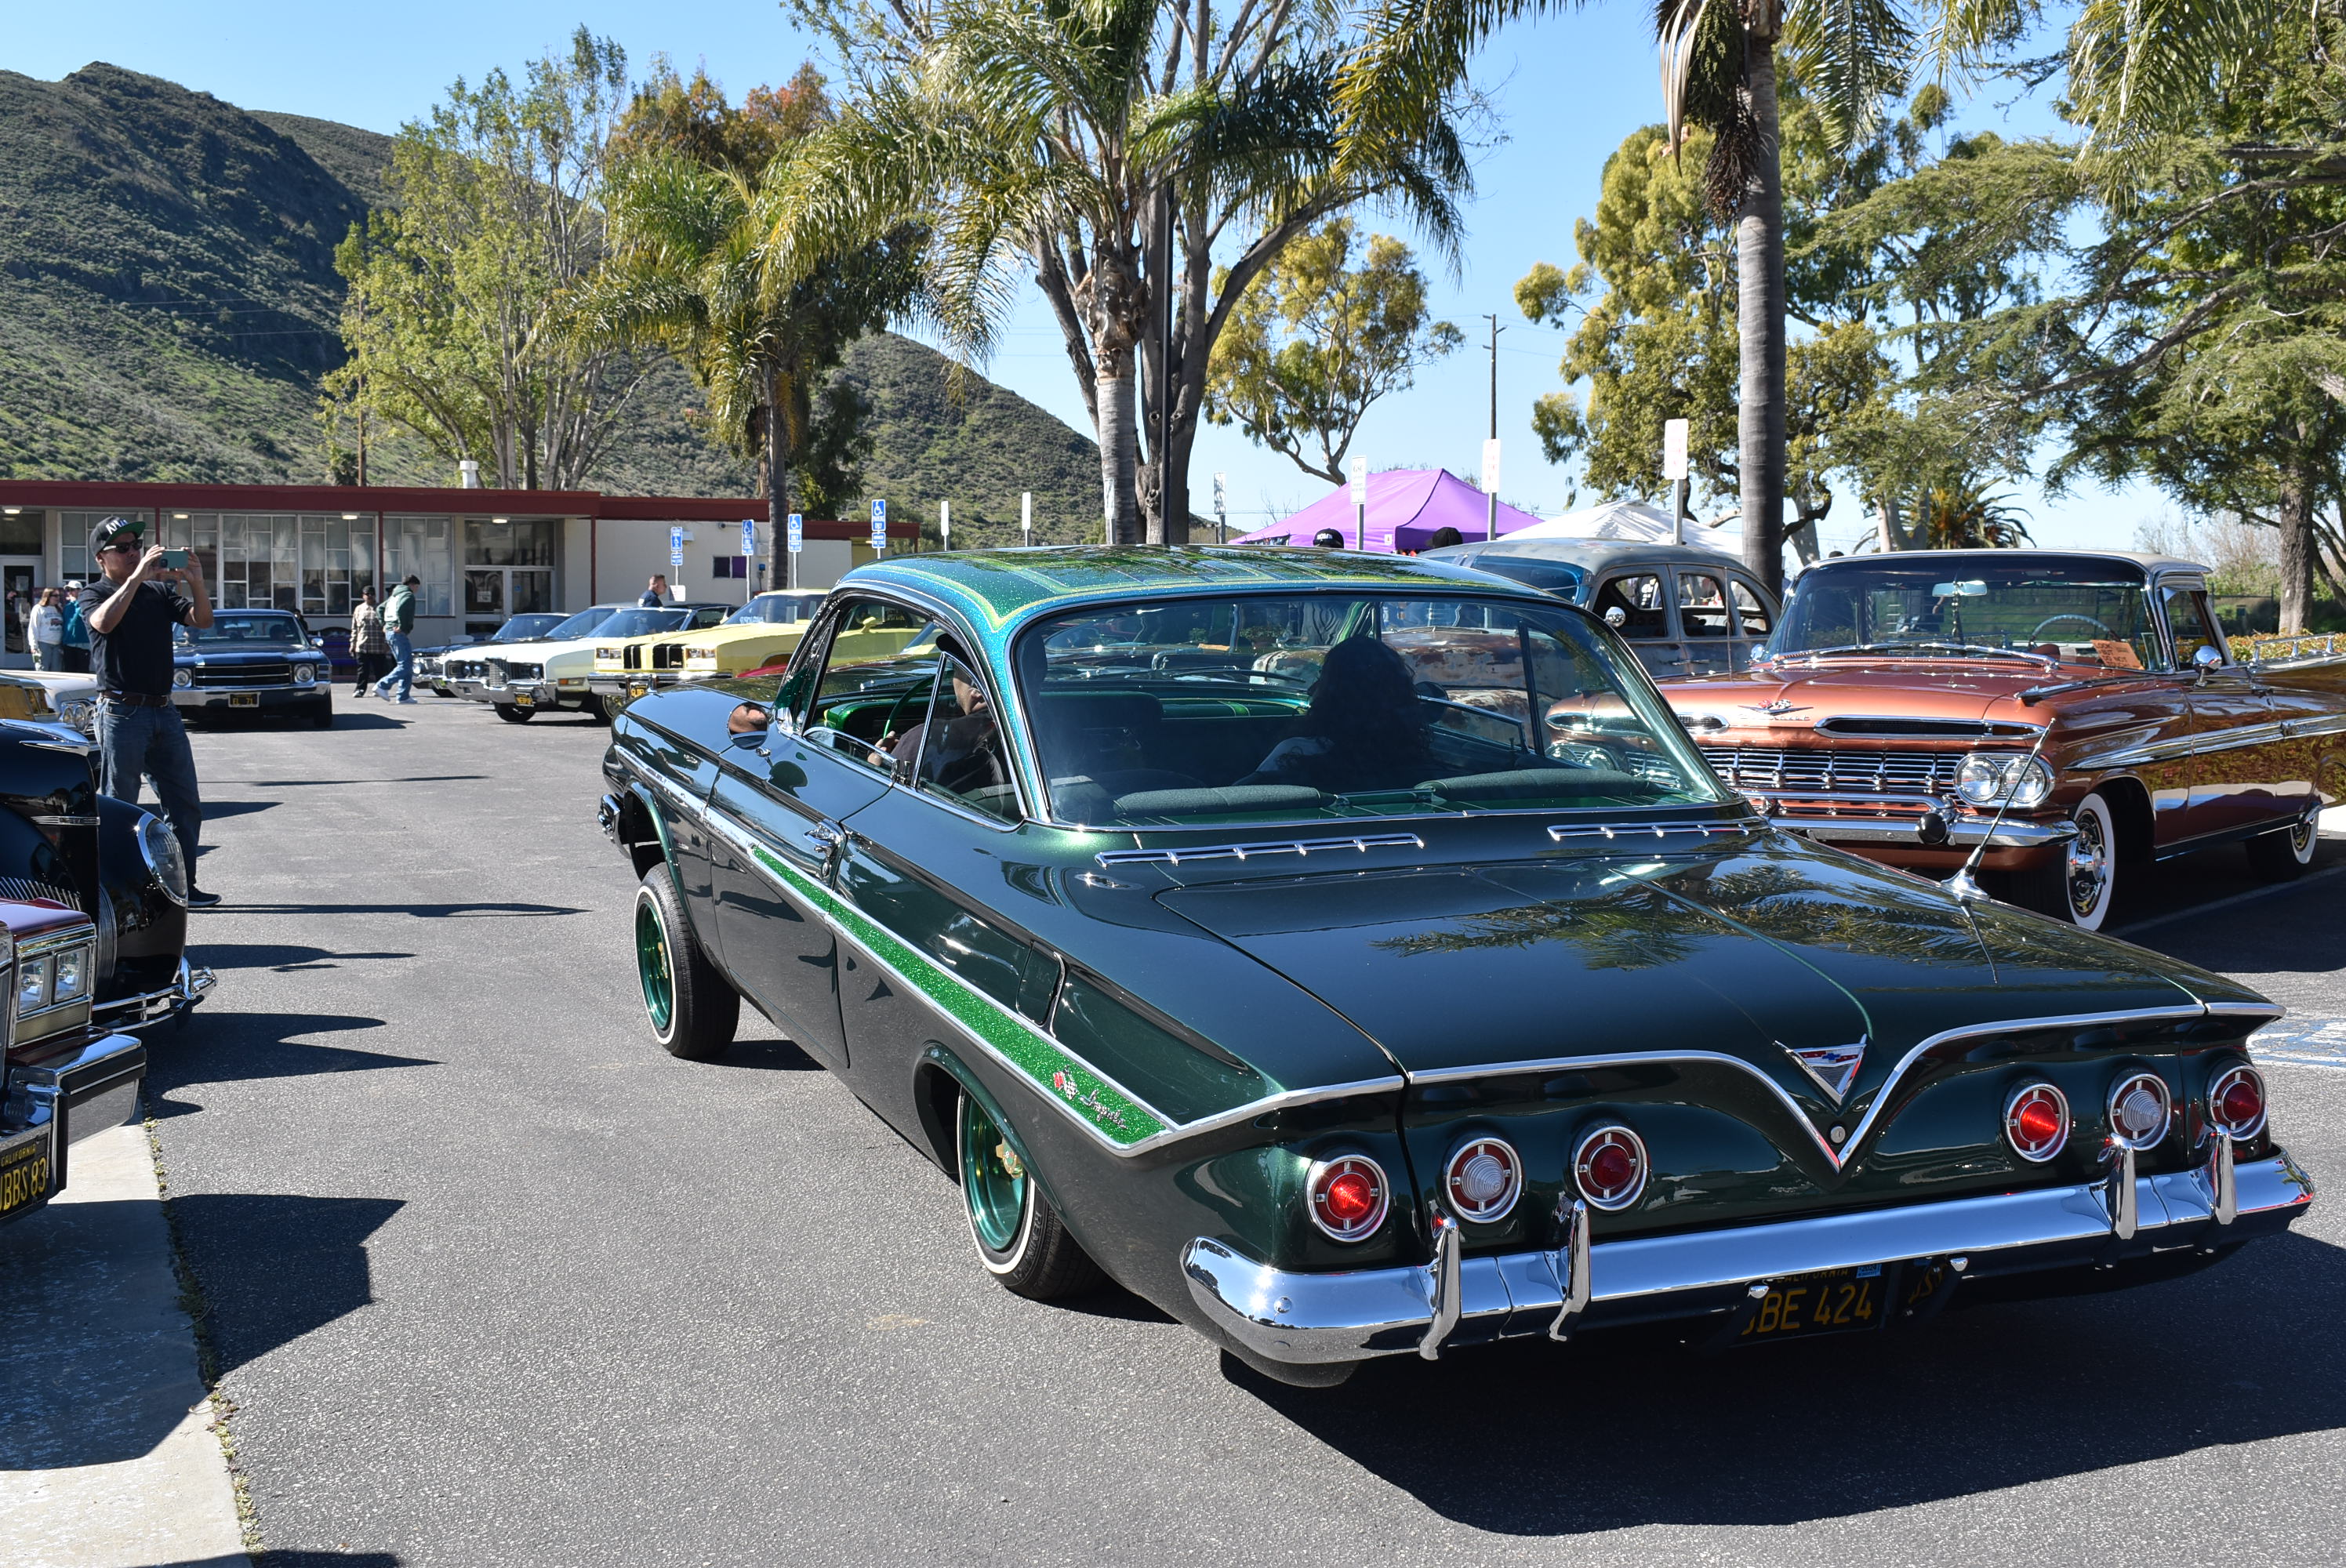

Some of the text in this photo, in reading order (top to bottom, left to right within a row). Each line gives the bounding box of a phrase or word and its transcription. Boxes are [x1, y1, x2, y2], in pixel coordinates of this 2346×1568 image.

[1080, 1089, 1128, 1129] Impala
[1, 1143, 36, 1167] CALIFORNIA
[31, 1156, 47, 1197] 83
[1814, 1280, 1872, 1326] 424
